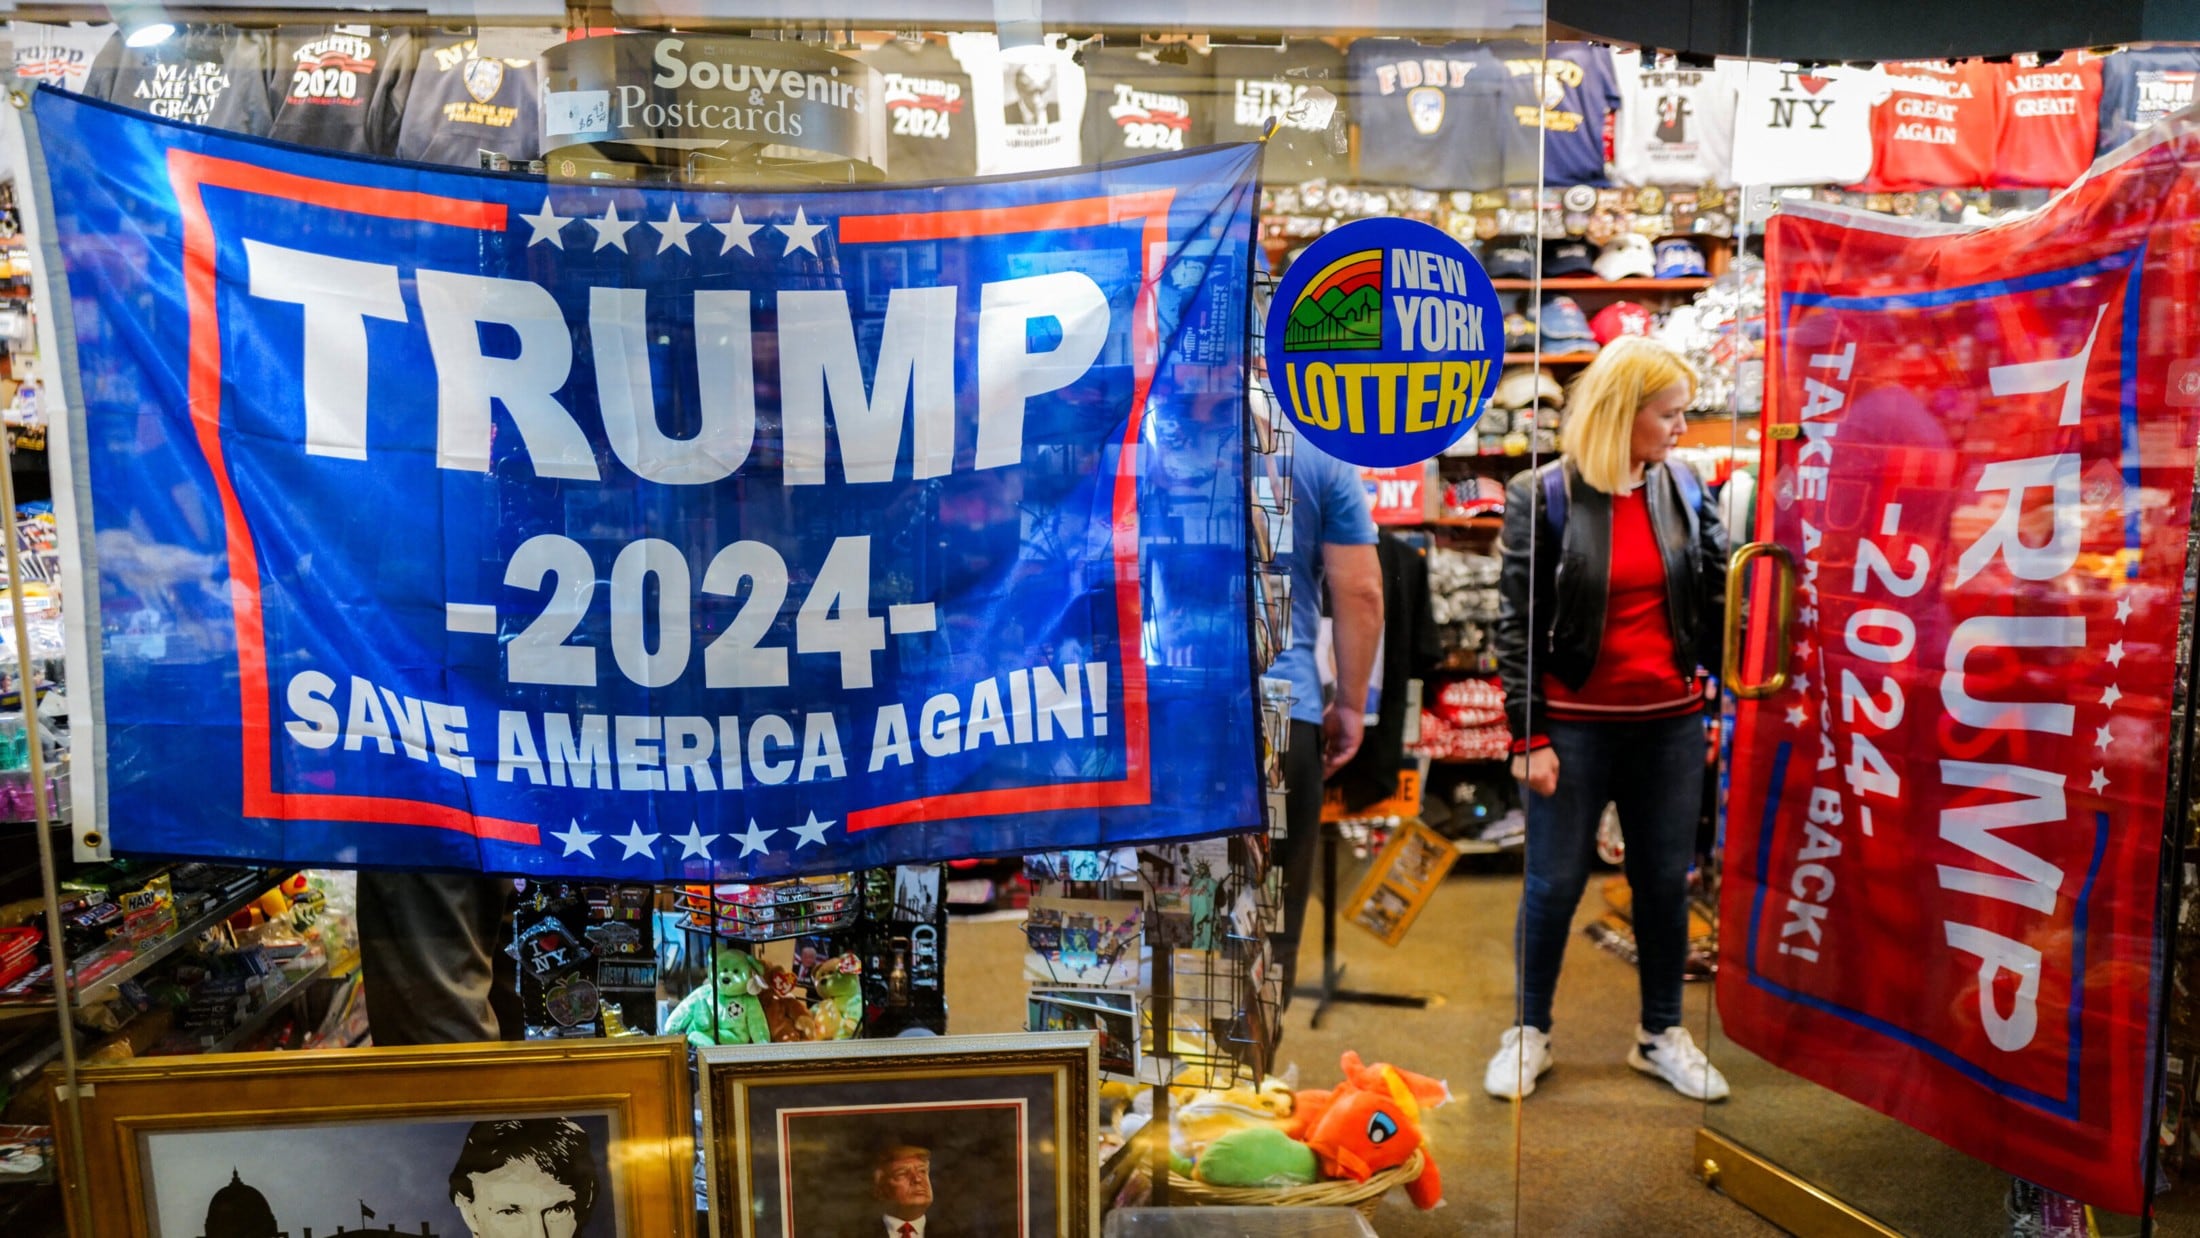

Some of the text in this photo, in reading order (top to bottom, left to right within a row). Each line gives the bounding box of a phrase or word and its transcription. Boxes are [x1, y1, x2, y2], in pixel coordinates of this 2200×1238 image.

[15, 45, 84, 64] rump
[293, 34, 371, 63] Trump
[293, 69, 357, 99] 2020
[653, 38, 865, 114] Souvenirs
[884, 73, 961, 104] Trump
[1375, 60, 1478, 95] FDNY
[2005, 74, 2084, 96] AMERICA
[616, 85, 803, 137] Postcards
[748, 88, 764, 106] &
[1113, 83, 1190, 117] Trump
[1768, 97, 1834, 129] NY
[1895, 98, 1958, 122] GREAT
[2014, 97, 2075, 118] GREAT!
[893, 107, 952, 140] 2024
[1894, 122, 1957, 145] AGAIN
[1391, 248, 1468, 297] NEW
[1392, 295, 1486, 352] YORK
[241, 237, 1111, 486] TRUMP
[1285, 359, 1492, 435] LOTTERY
[1796, 341, 1857, 502] TAKE
[445, 533, 937, 690] -2024-
[1841, 502, 1930, 837] -2024-
[1936, 302, 2110, 1053] TRUMP
[283, 660, 1108, 793] SAVE AMERICA AGAIN!
[1777, 786, 1845, 965] BACK!
[626, 966, 656, 985] YORK
